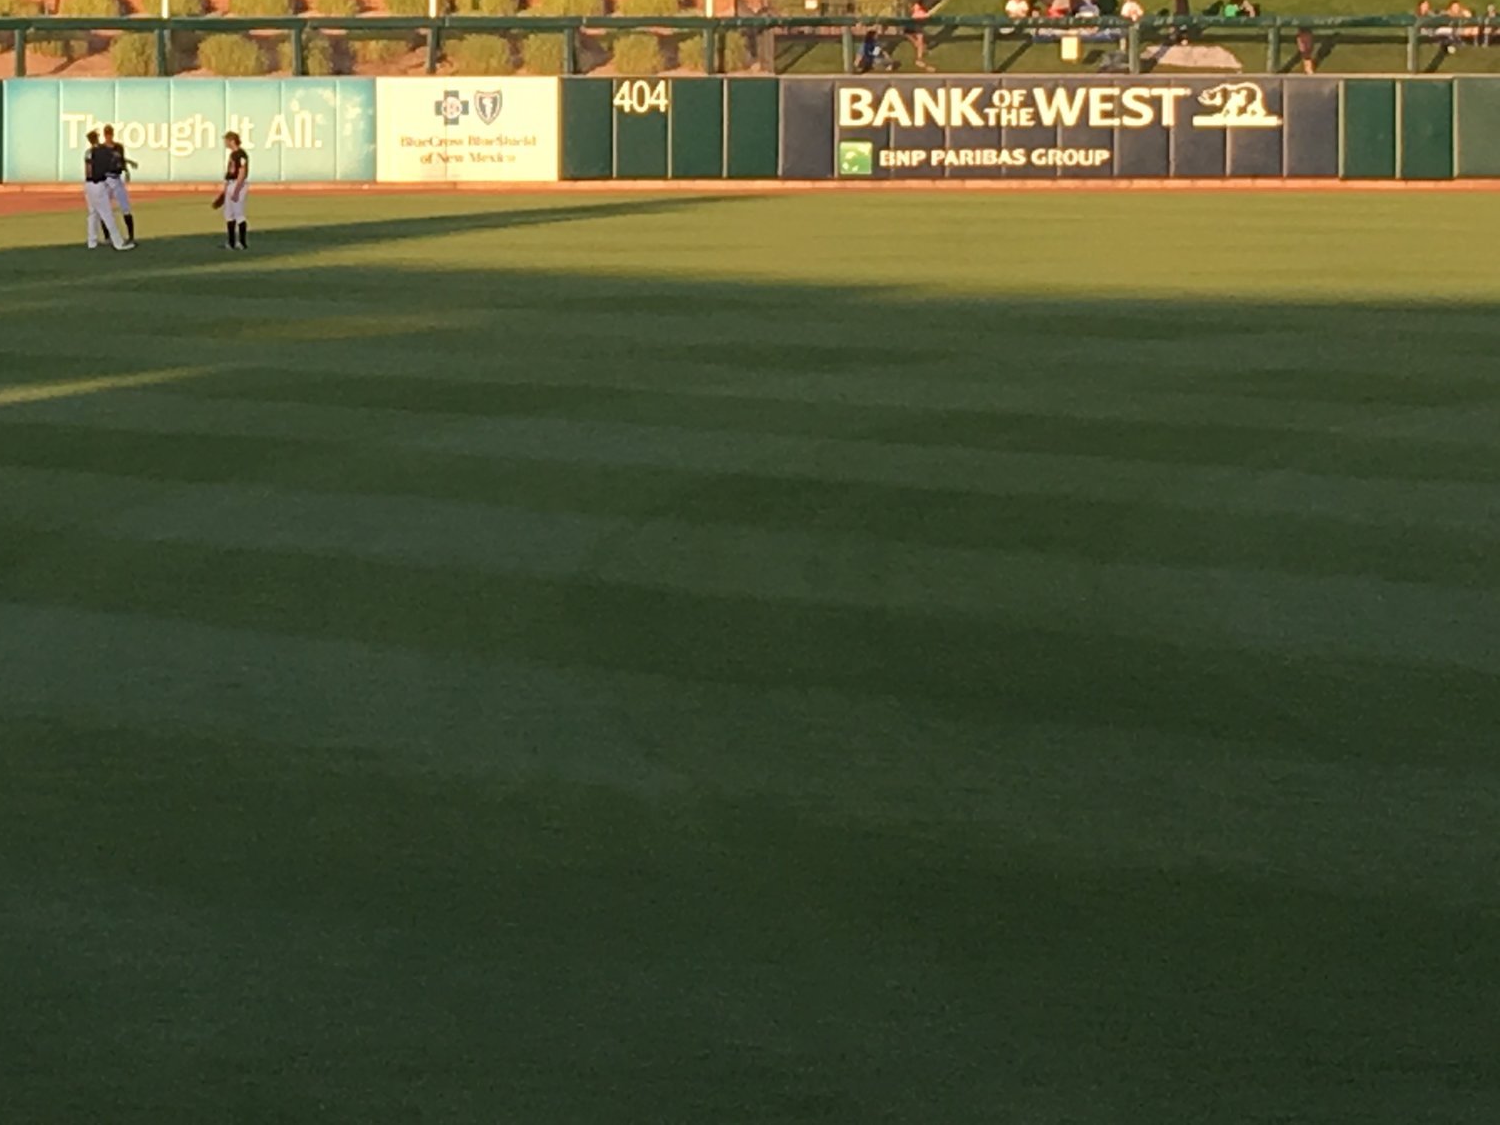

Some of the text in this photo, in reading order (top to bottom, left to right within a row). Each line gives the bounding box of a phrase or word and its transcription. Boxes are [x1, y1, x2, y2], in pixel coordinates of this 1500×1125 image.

[613, 80, 669, 113] 404
[839, 87, 1188, 127] BANK OF THE WEST
[62, 113, 216, 157] Through
[879, 148, 1111, 166] BNP PARIBAS GROUP
